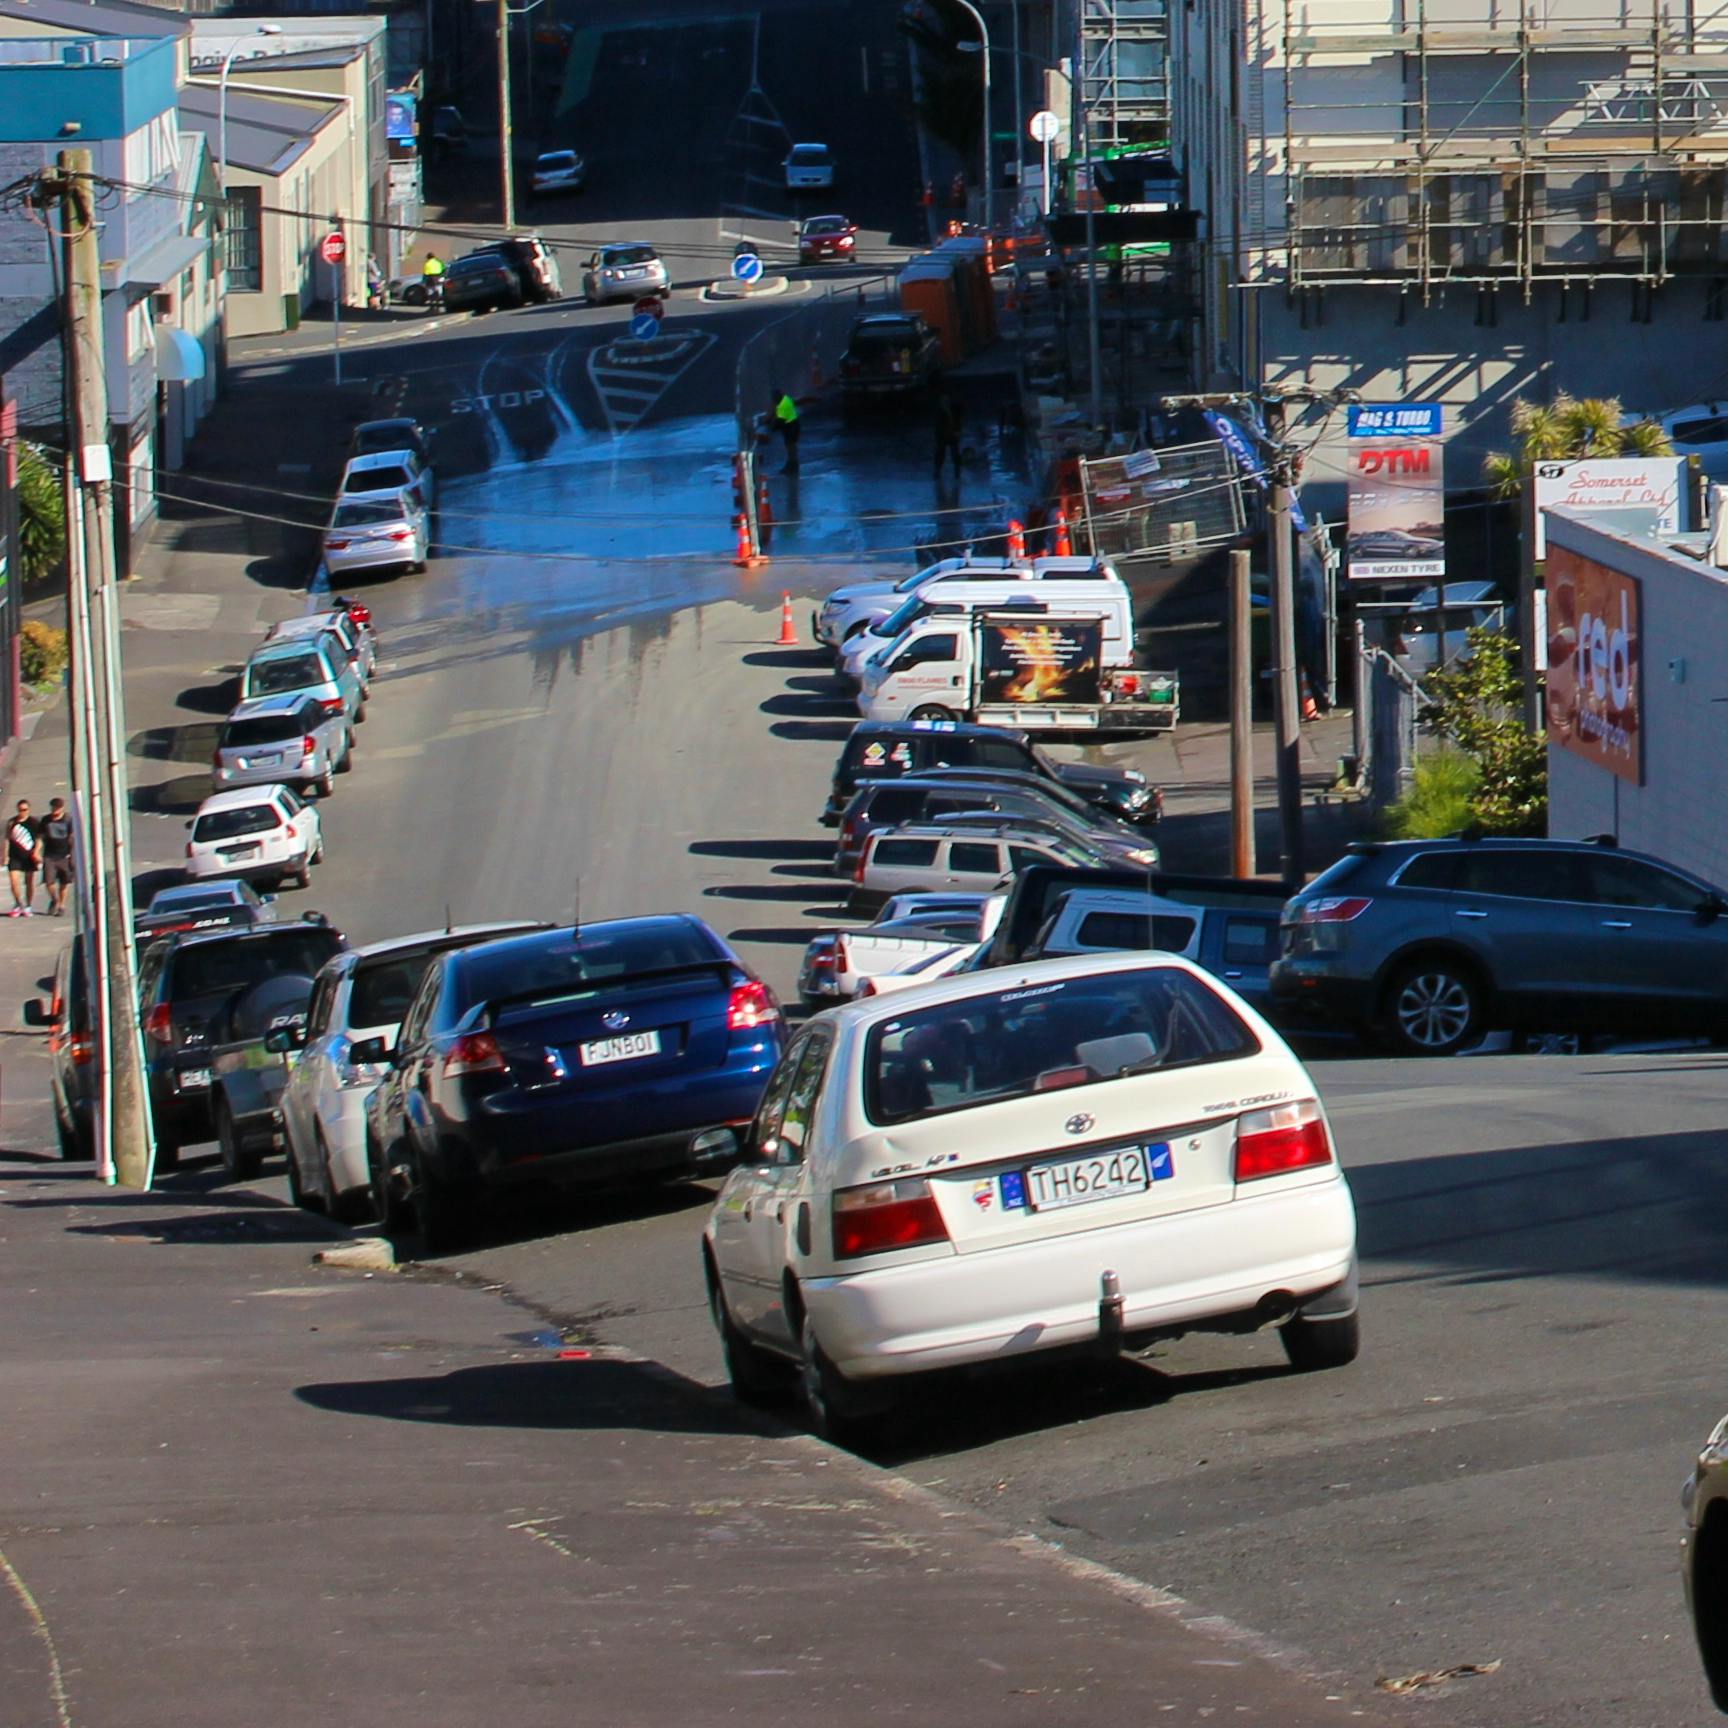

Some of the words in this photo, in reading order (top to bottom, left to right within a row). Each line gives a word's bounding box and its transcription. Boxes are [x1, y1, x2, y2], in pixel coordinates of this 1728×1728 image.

[450, 389, 545, 414] STOP
[1357, 411, 1384, 427] MAG
[1396, 410, 1432, 427] TURBO
[1358, 448, 1430, 474] DTM
[1568, 470, 1649, 489] Somerset
[1372, 565, 1408, 575] NEXEN
[1411, 564, 1441, 574] TYRE
[1032, 1149, 1143, 1201] TH6242
